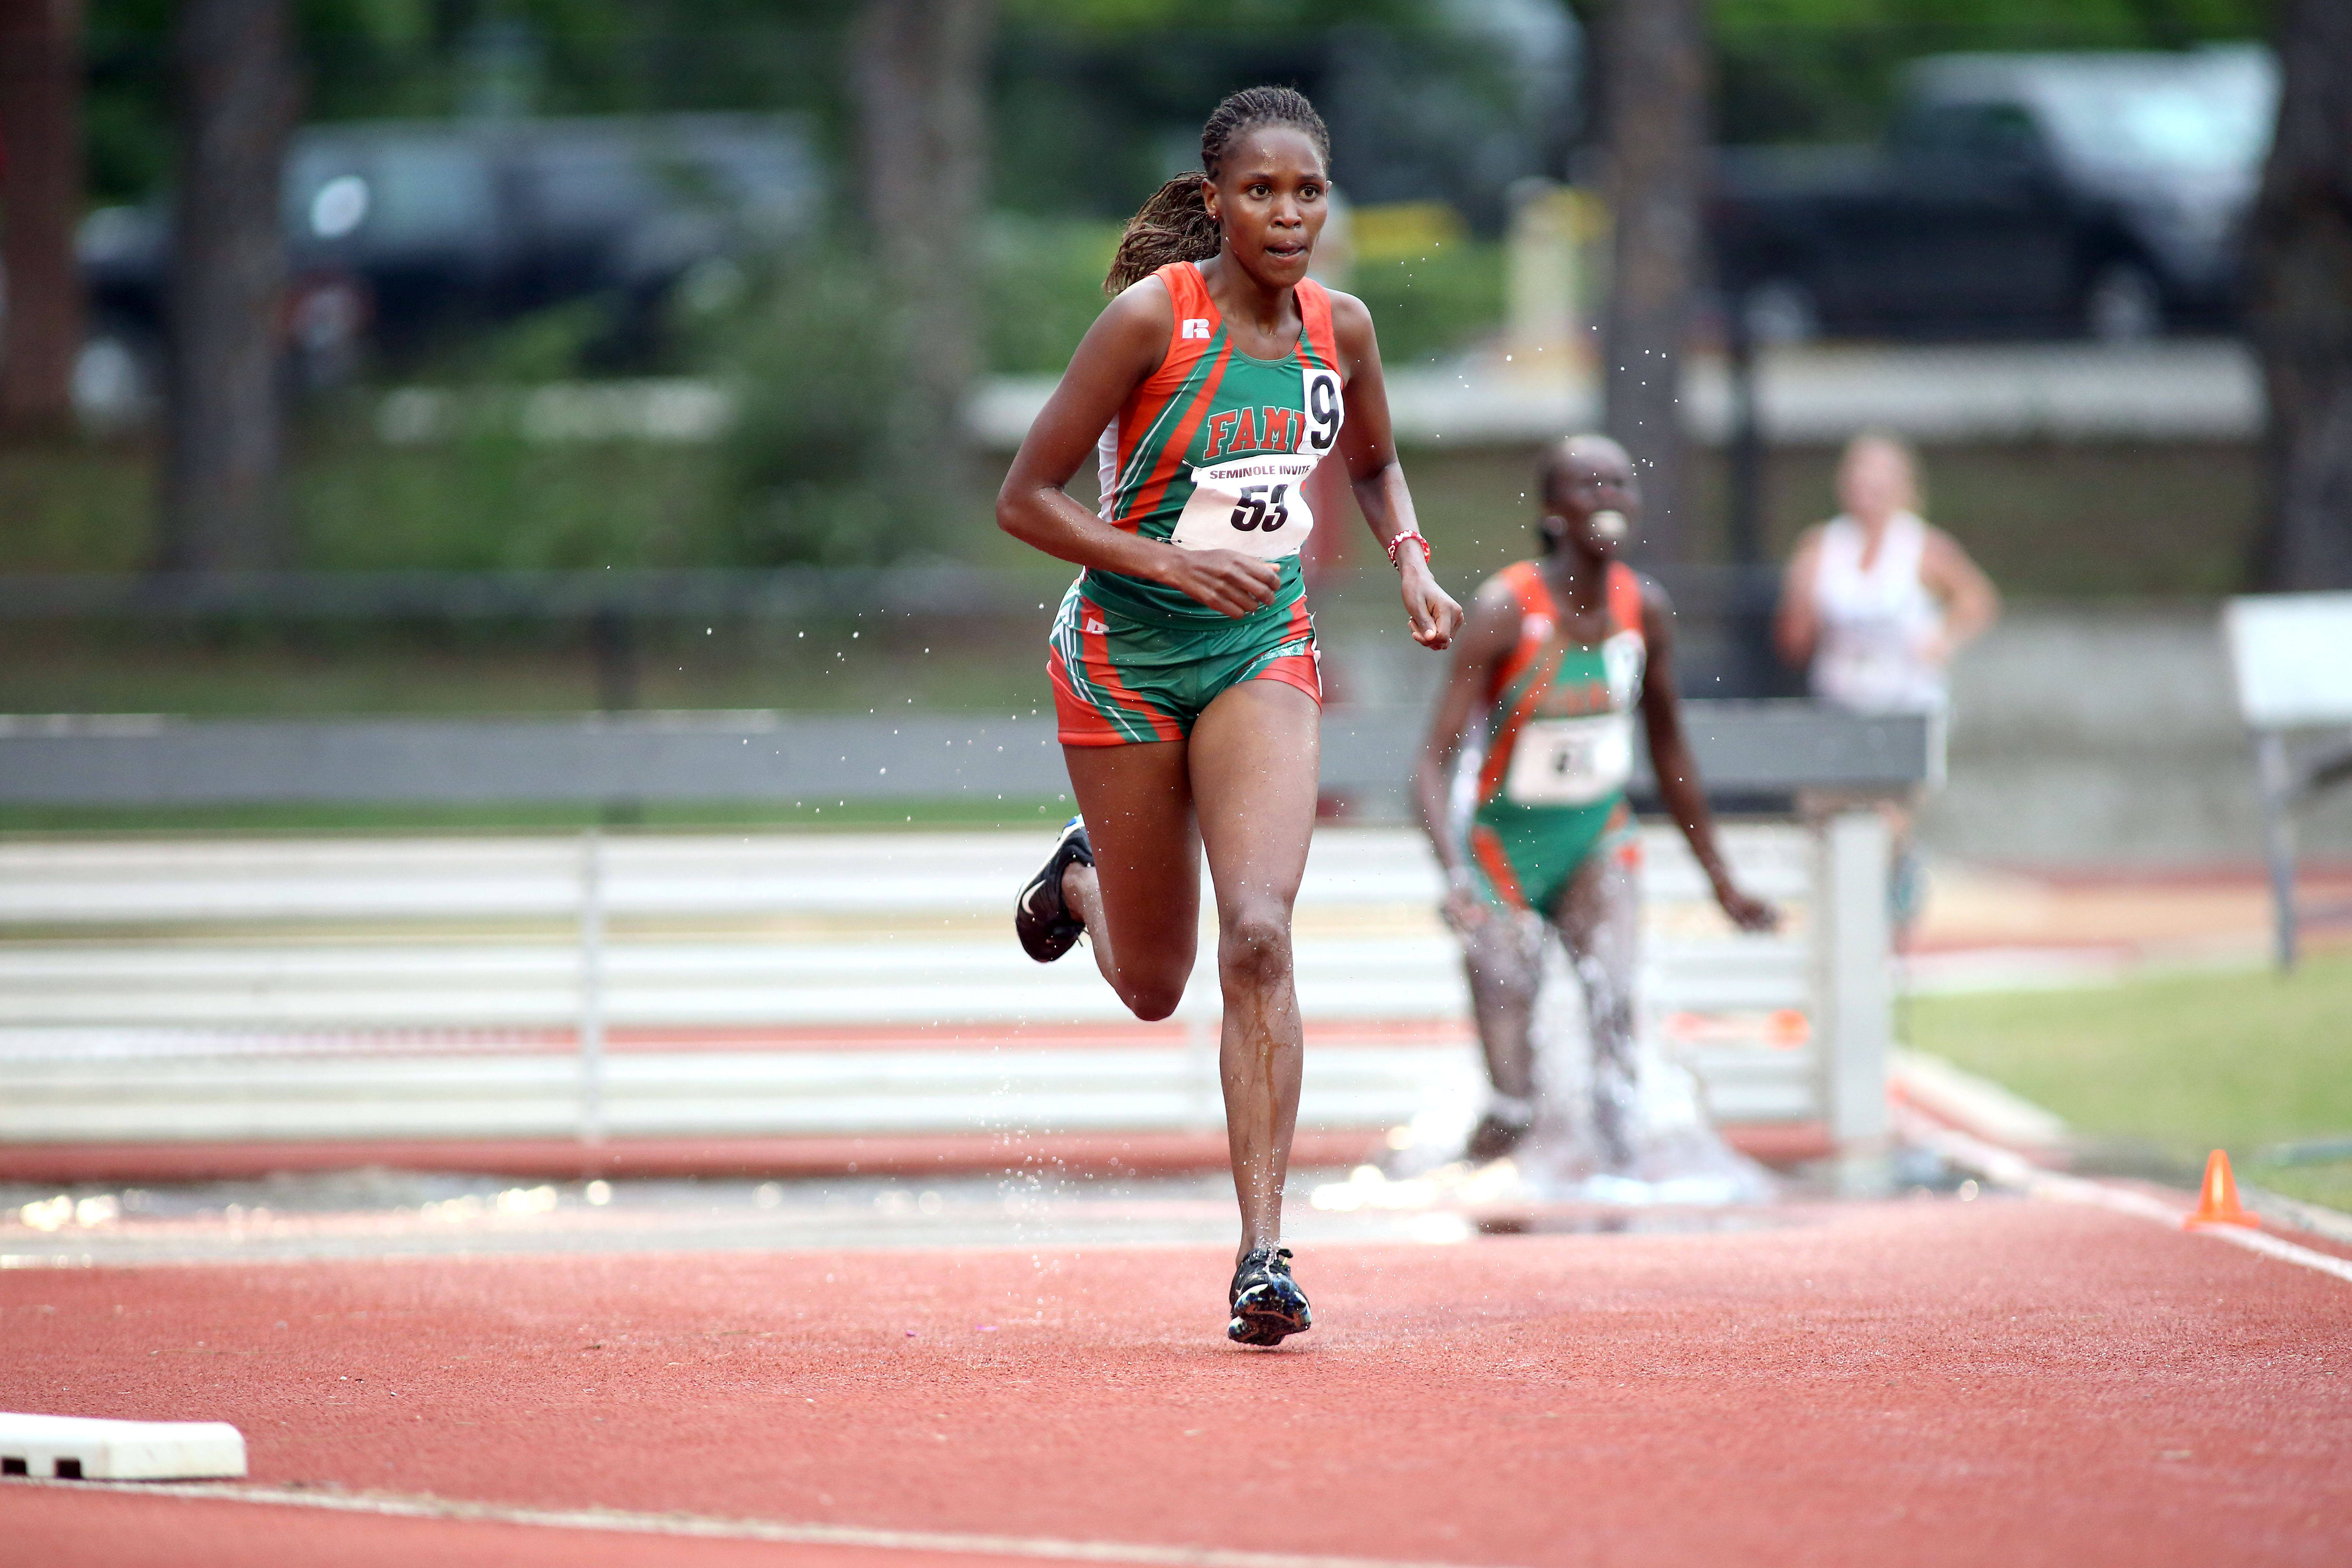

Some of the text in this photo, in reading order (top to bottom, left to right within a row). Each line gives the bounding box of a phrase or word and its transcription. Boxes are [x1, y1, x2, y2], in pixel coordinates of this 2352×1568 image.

[1182, 318, 1210, 339] R
[1311, 375, 1339, 449] 9
[1210, 466, 1275, 479] SEMINOLE
[1231, 484, 1288, 532] 53
